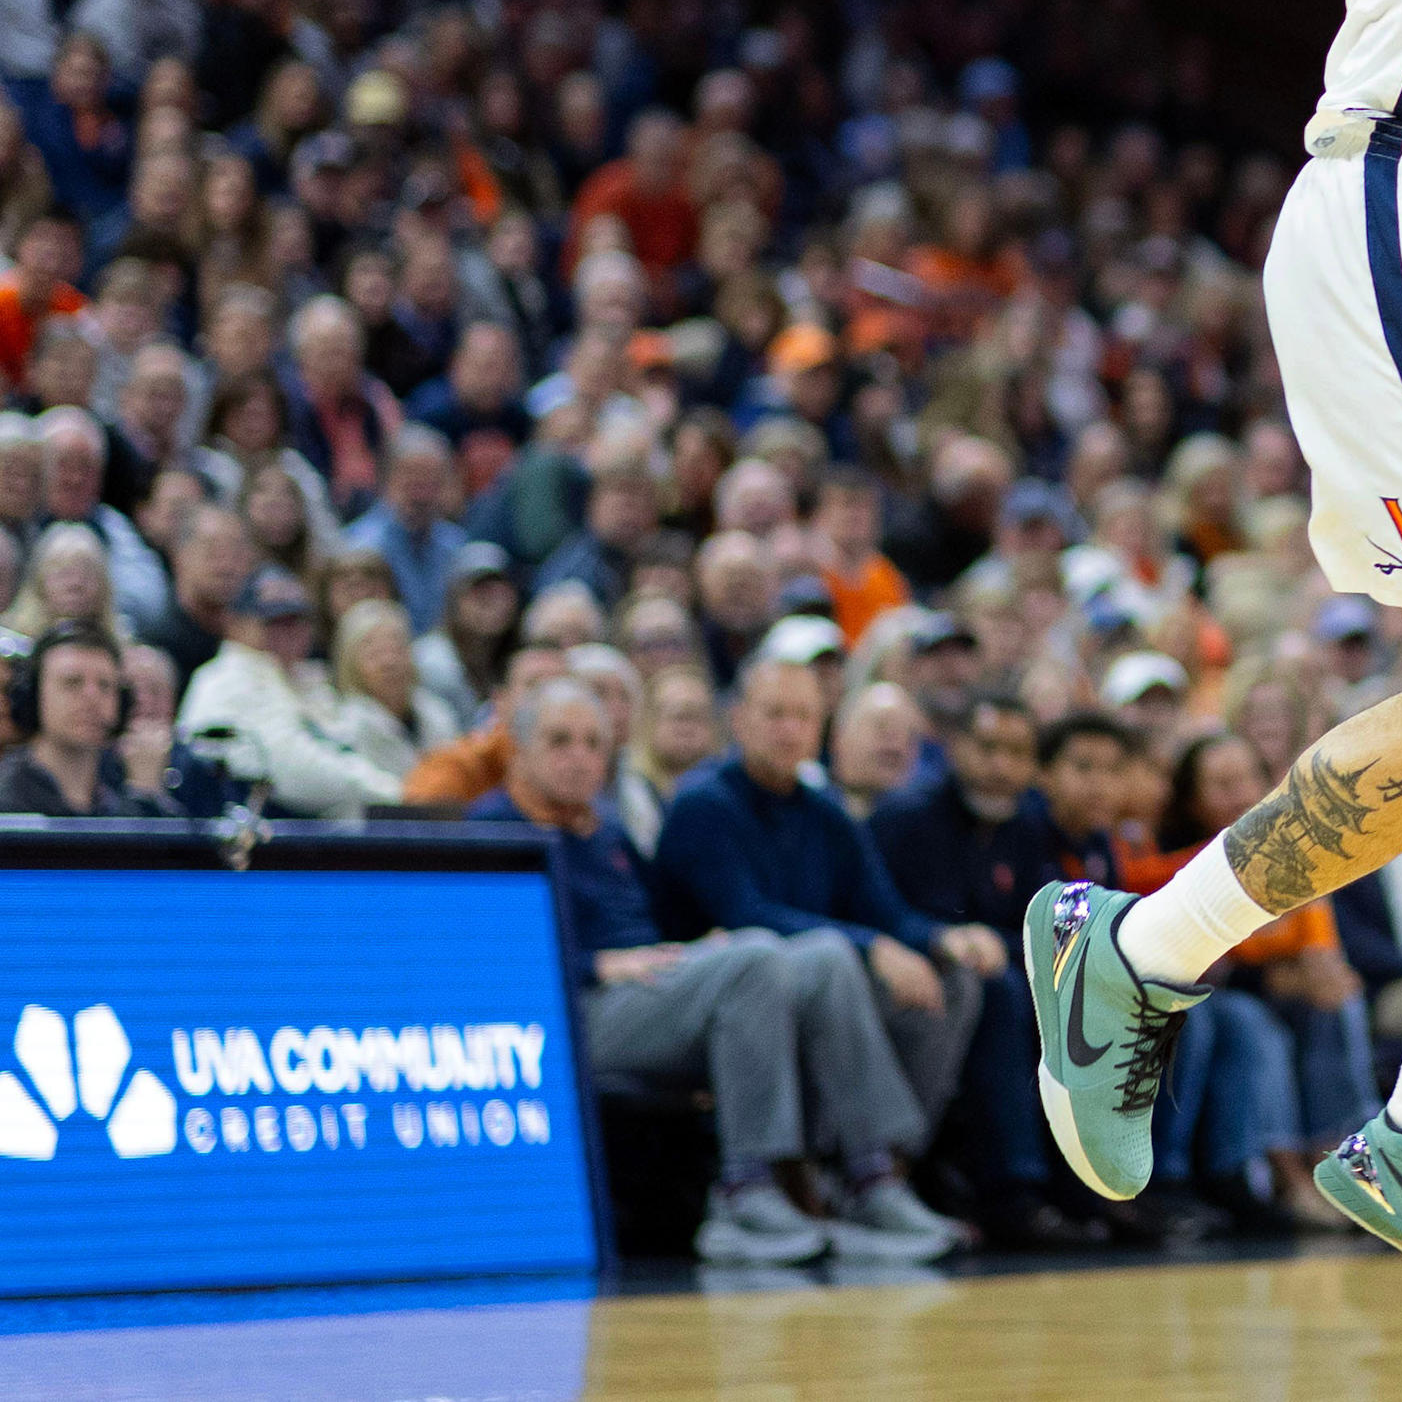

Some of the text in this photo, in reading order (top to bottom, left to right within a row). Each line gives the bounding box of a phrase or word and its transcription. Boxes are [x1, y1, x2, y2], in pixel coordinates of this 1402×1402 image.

[172, 1023, 545, 1096] UVA COMMUNITY
[184, 1098, 551, 1154] CREDIT UNION
